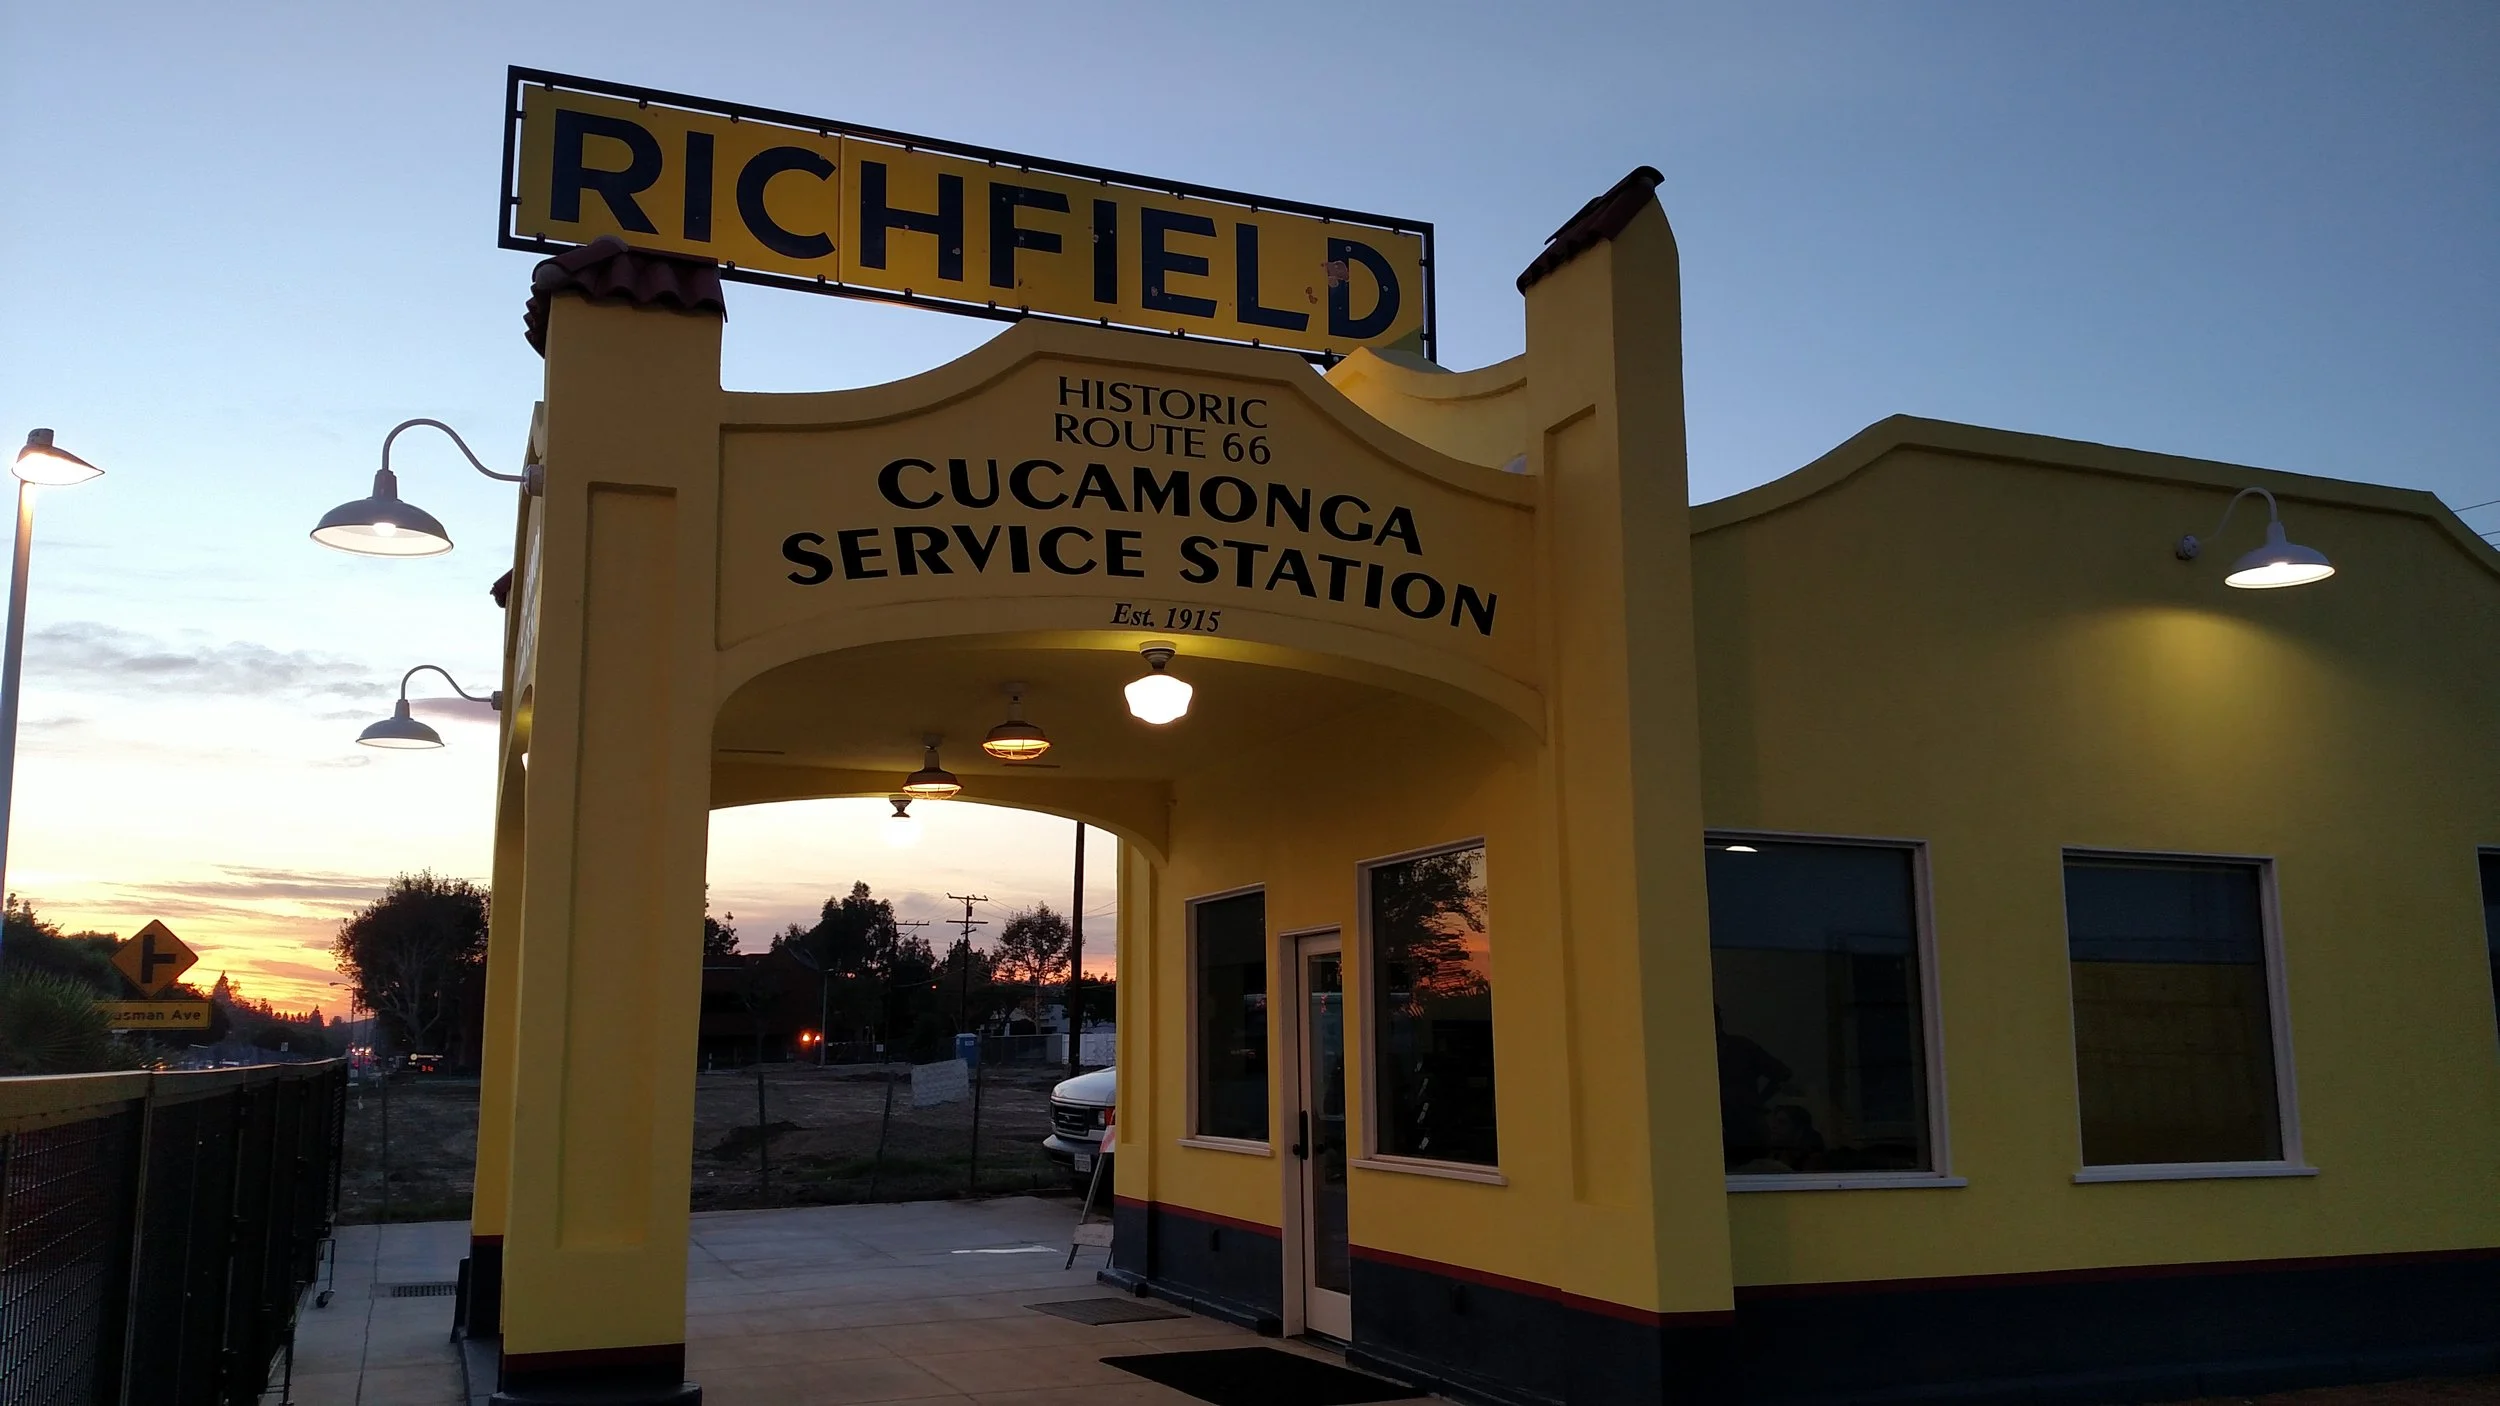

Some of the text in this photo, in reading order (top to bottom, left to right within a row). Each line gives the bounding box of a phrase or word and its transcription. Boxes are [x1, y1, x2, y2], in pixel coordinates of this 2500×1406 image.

[550, 108, 1401, 341] RICHFIELD
[1058, 375, 1269, 430] HISTORIC
[1054, 412, 1272, 466] ROUTE 66
[877, 458, 1423, 556] CUCAMONGA
[781, 525, 1498, 637] SERVICE STATION
[1109, 602, 1222, 633] Est. 1915
[171, 1009, 202, 1021] Ave
